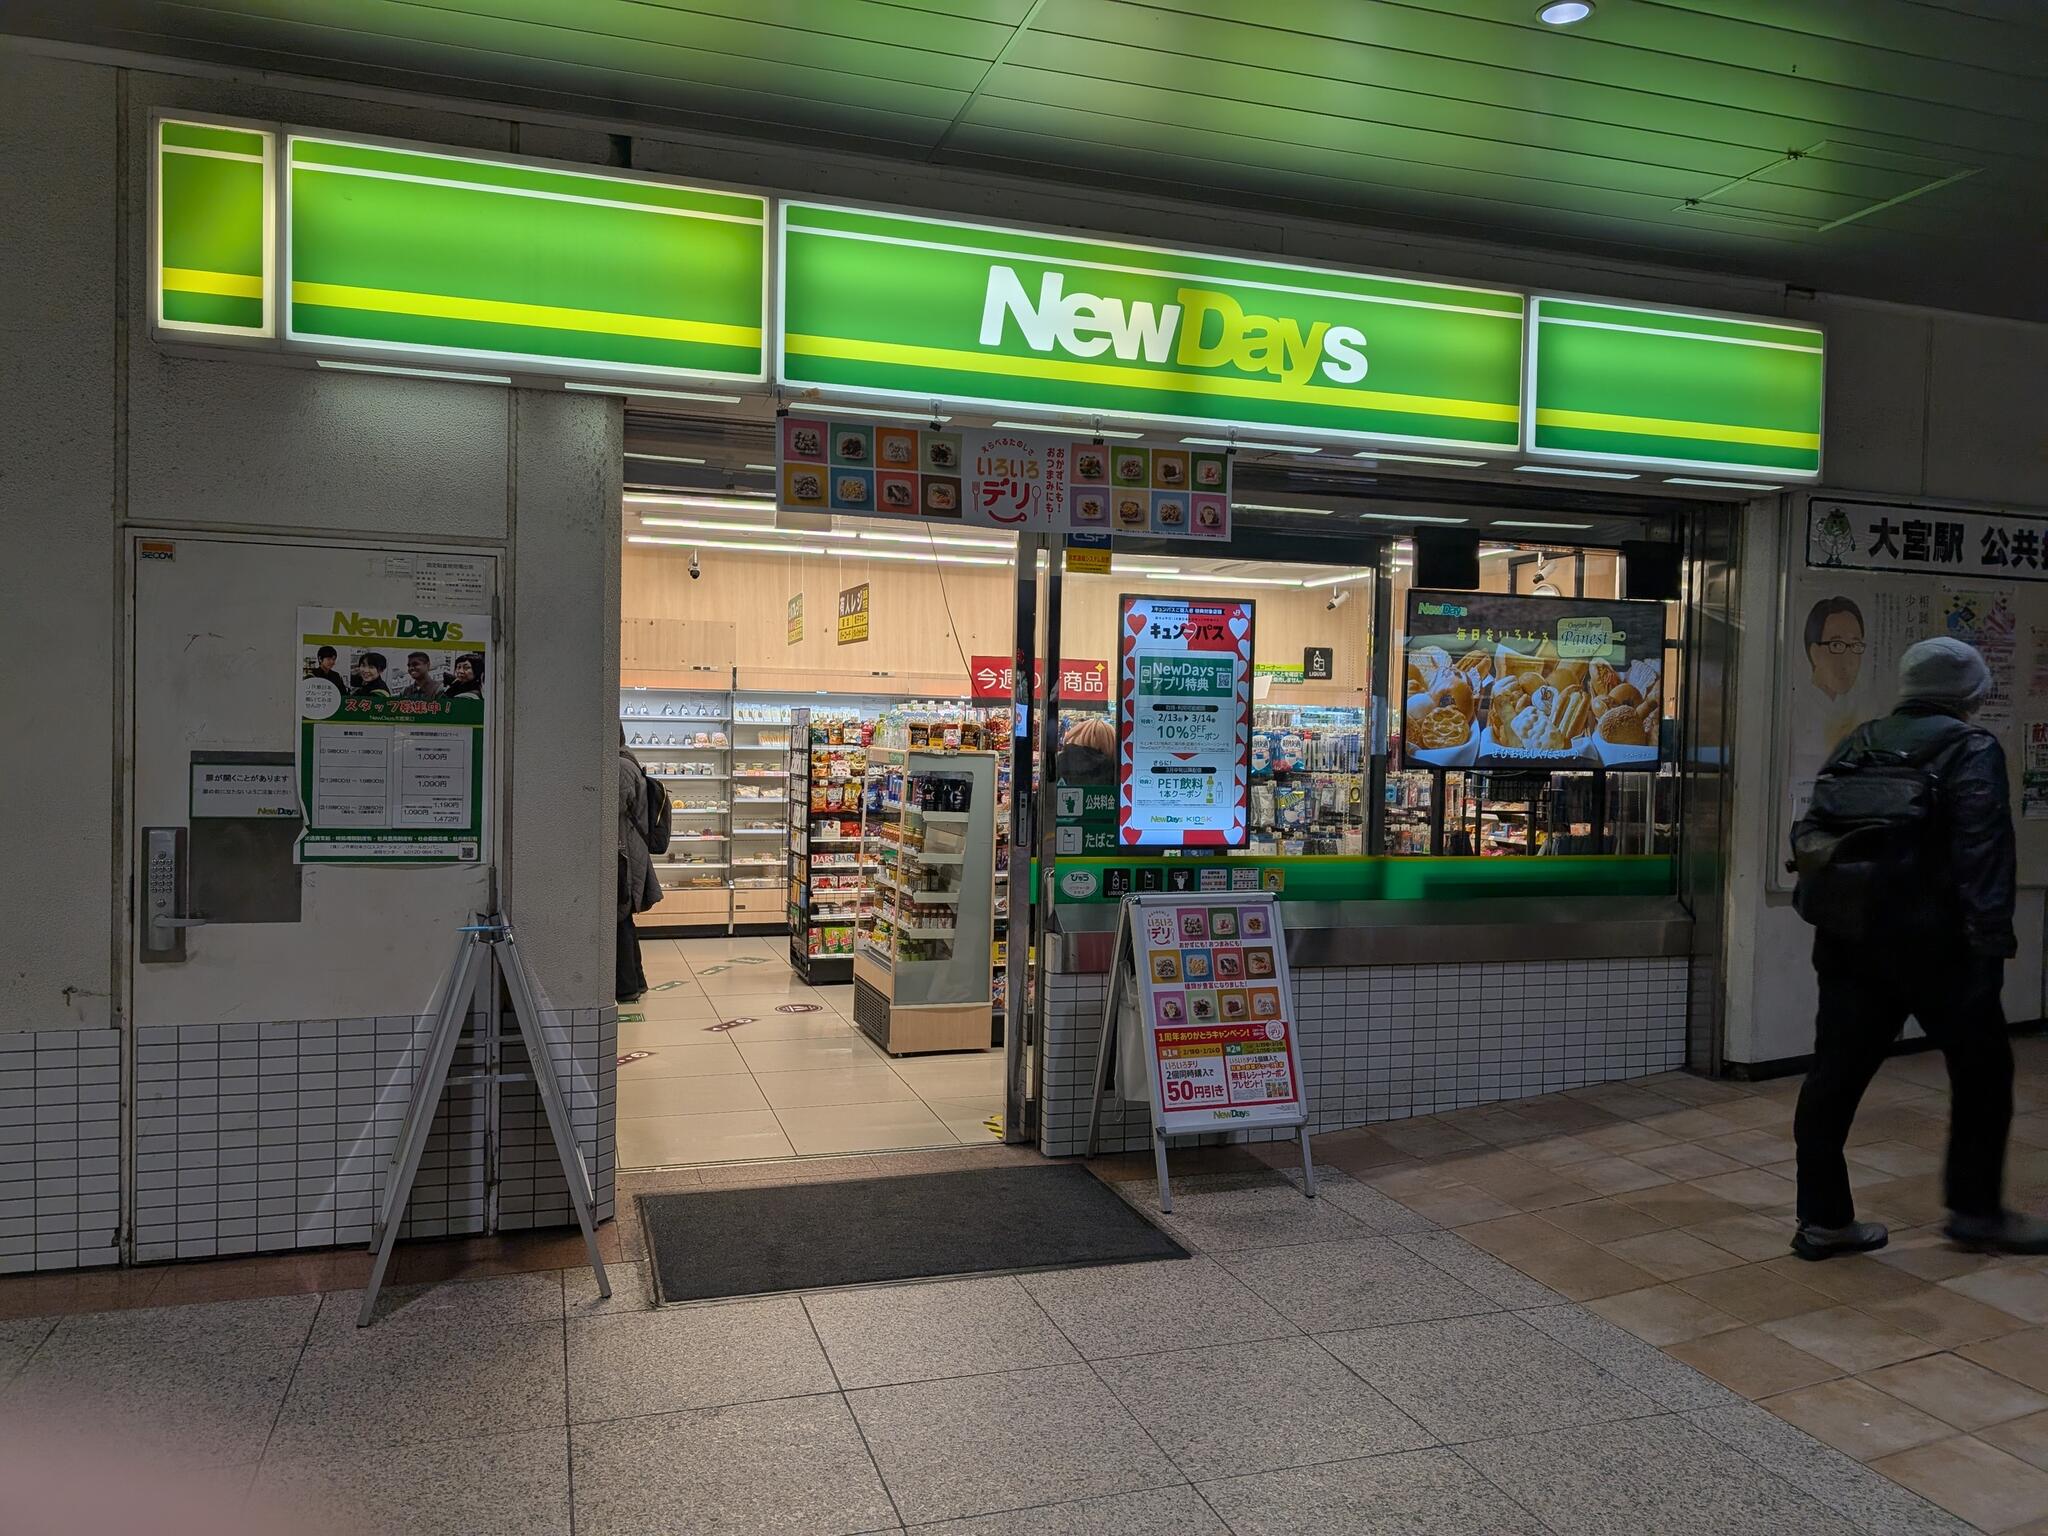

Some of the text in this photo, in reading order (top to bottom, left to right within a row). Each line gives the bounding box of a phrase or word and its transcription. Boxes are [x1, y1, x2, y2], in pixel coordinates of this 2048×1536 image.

[978, 264, 1369, 386] NewDays
[976, 456, 1040, 479] いろいろ
[982, 478, 1030, 509] デリ
[1868, 517, 1965, 563] 大宮駅
[141, 551, 174, 560] SECOM
[1418, 601, 1468, 617] NewDays
[332, 611, 463, 642] NewDays
[1456, 626, 1549, 643] 毎日をいろどる
[1561, 630, 1608, 647] Panest
[1152, 662, 1215, 678] NewDays
[1152, 677, 1210, 692] アプリ特典
[1156, 724, 1207, 739] 10% OFF
[1189, 733, 1220, 741] クーポン
[205, 773, 289, 783] 扉が開くことがあります
[1158, 777, 1204, 790] PET飲料
[1159, 789, 1202, 799] 1本クーポン
[1085, 794, 1116, 811] 公共料金
[257, 807, 299, 816] NewDays
[1151, 815, 1183, 824] NewDays
[1085, 833, 1115, 848] たばこ
[812, 855, 834, 864] DARS
[1147, 917, 1173, 927] いろいろ
[1151, 926, 1171, 940] デリ
[1165, 1060, 1198, 1070] いろいろデリ
[1166, 1080, 1225, 1102] 50円引き
[1213, 1109, 1250, 1119] NewDays
